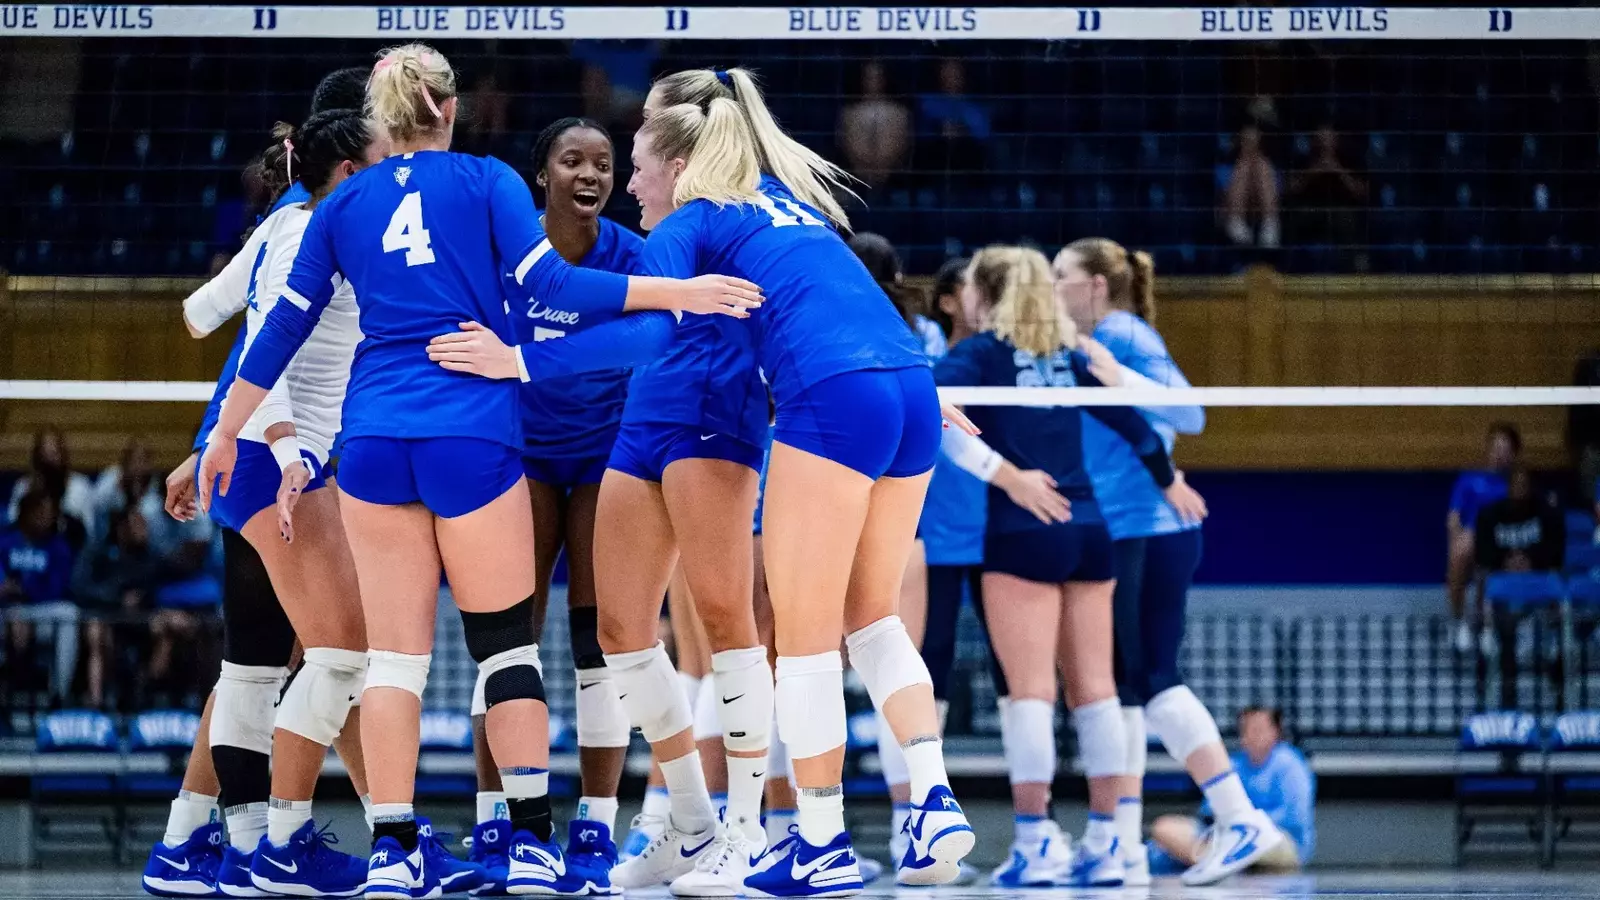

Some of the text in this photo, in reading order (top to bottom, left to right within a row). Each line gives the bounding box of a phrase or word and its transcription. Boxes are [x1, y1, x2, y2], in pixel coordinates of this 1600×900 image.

[53, 8, 153, 29] DEVILS
[376, 9, 448, 30] BLUE
[466, 9, 564, 30] DEVILS
[789, 9, 860, 30] BLUE
[878, 9, 976, 30] DEVILS
[1201, 10, 1272, 31] BLUE
[1289, 9, 1388, 31] DEVILS
[382, 191, 436, 267] 4
